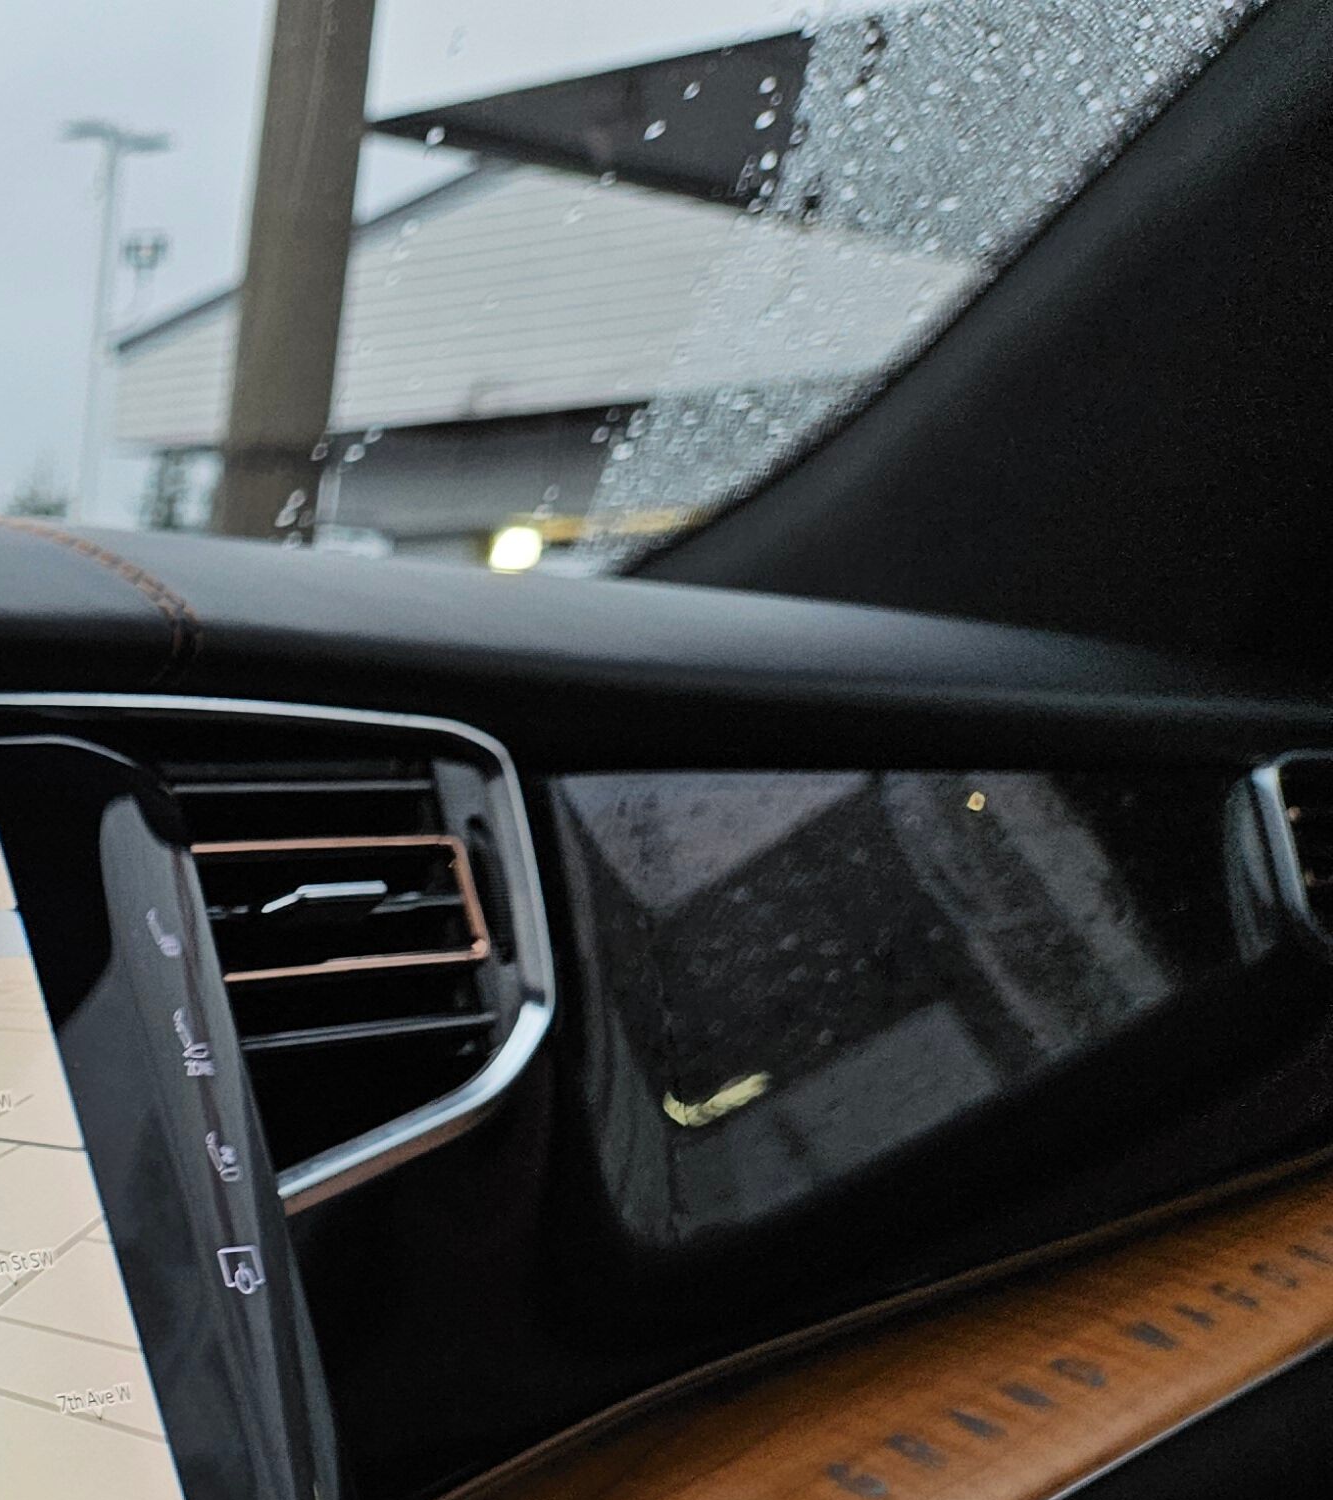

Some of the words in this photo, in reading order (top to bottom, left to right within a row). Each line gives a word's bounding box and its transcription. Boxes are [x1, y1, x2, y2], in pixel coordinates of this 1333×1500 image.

[12, 1254, 28, 1270] St
[31, 1250, 55, 1267] SW
[57, 1394, 84, 1412] 7th
[88, 1391, 115, 1406] Ave
[116, 1385, 131, 1401] W
